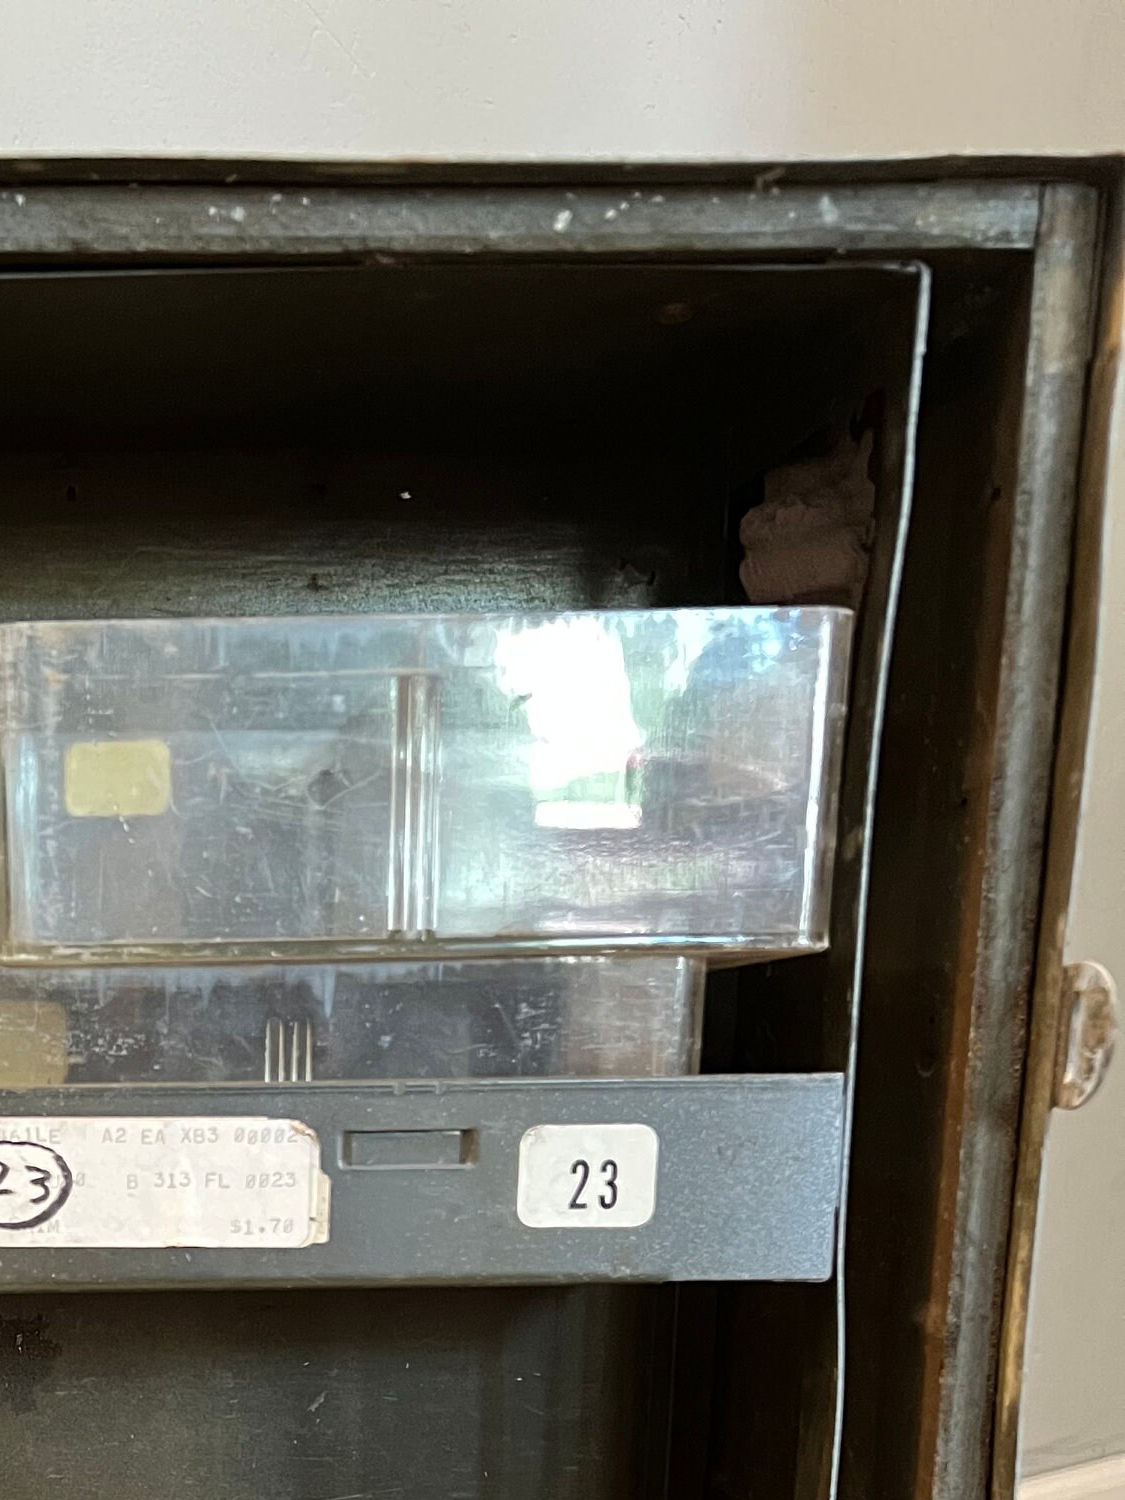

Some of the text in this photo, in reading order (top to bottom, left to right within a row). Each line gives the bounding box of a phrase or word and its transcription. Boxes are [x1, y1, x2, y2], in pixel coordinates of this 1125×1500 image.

[101, 1127, 127, 1144] A2
[140, 1128, 166, 1146] EA
[153, 1171, 191, 1189] 313
[204, 1172, 231, 1189] FL
[245, 1171, 297, 1189] 0023
[568, 1159, 619, 1210] 23
[230, 1218, 294, 1236] $1.70
